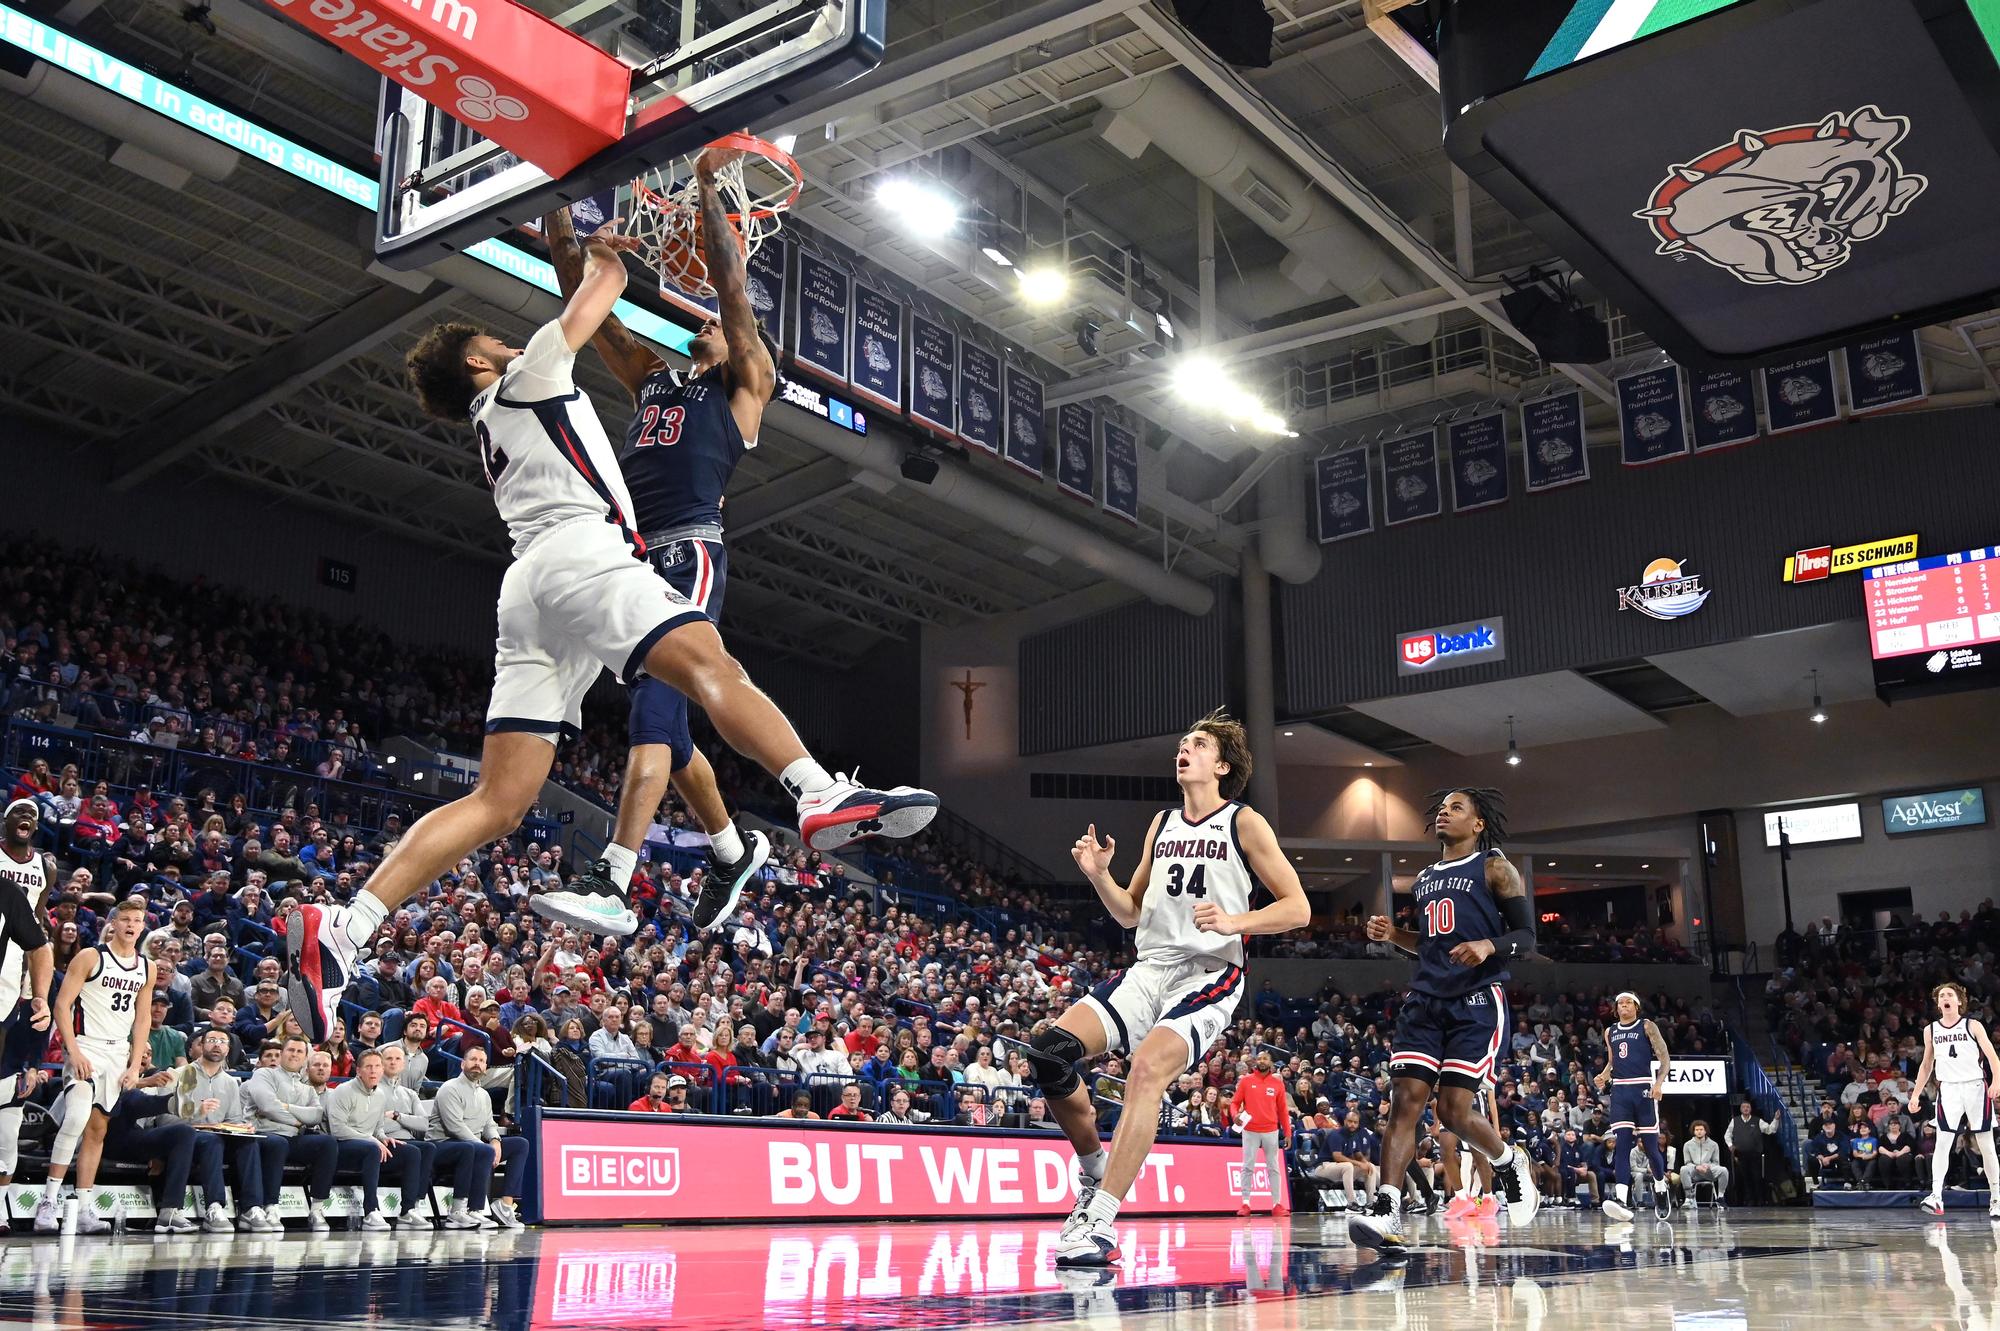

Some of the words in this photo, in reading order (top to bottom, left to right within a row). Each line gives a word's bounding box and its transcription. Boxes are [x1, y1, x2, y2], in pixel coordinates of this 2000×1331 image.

[310, 0, 459, 86] State
[0, 9, 144, 101] ELIEVE
[154, 83, 181, 114] in
[188, 103, 285, 167] adding
[291, 151, 373, 203] smiles
[752, 259, 783, 280] Regional
[813, 280, 835, 298] NCAA
[804, 287, 819, 301] 2nd
[819, 297, 845, 314] Round
[867, 309, 888, 327] NCAA
[858, 316, 874, 329] 2nd
[873, 324, 898, 342] Round
[1860, 339, 1880, 351] Final
[1881, 336, 1900, 347] Four
[915, 347, 929, 360] 2nd
[930, 354, 952, 371] Round
[1769, 363, 1794, 375] Sweet
[1796, 355, 1827, 368] Sixteen
[1637, 387, 1661, 400] NCAA
[1700, 382, 1718, 393] Elite
[1720, 376, 1742, 389] Eight
[1628, 401, 1647, 411] Third
[1647, 392, 1674, 406] Round
[837, 407, 845, 421] 4
[1541, 413, 1564, 426] NCAA
[635, 404, 686, 448] 23
[1551, 419, 1577, 430] Round
[1797, 553, 1829, 575] Tires
[1833, 552, 1854, 567] LES
[1857, 541, 1914, 563] SCHWAB
[330, 567, 350, 583] 115
[1978, 564, 1986, 572] 2
[1616, 578, 1703, 611] KALISPEL
[1875, 589, 1881, 597] 4
[1885, 585, 1919, 596] Stromer
[1980, 573, 1987, 581] 3
[1873, 599, 1885, 607] 11
[1886, 594, 1923, 606] Hickman
[1982, 583, 1988, 591] 1
[1874, 609, 1886, 617] 22
[1888, 605, 1919, 616] Watson
[1983, 592, 1990, 600] 7
[1875, 619, 1887, 627] 34
[1889, 615, 1907, 626] Huff
[1956, 605, 1968, 615] 12
[1984, 602, 1991, 610] 3
[1435, 624, 1493, 655] bank
[1950, 649, 1972, 659] Idaho
[1950, 653, 1981, 665] Central
[31, 735, 50, 748] 114
[1890, 800, 1963, 826] AgWest
[1921, 817, 1939, 825] FARM
[1939, 815, 1960, 823] CREDIT
[534, 829, 547, 839] 114
[1155, 839, 1228, 861] GONZAGA
[0, 869, 43, 888] ONZAGA
[1166, 863, 1207, 899] 34
[1415, 878, 1447, 902] JACKSON
[1447, 876, 1475, 893] STATE
[1424, 897, 1455, 937] 10
[111, 993, 131, 1012] 33
[1934, 1033, 1969, 1044] GONZAGA
[1619, 1042, 1627, 1058] 3
[1949, 1044, 1957, 1058] 4
[1655, 1068, 1715, 1082] EADY
[22, 1112, 46, 1122] ADY
[768, 1141, 903, 1206] BUT
[919, 1145, 1024, 1206] WE
